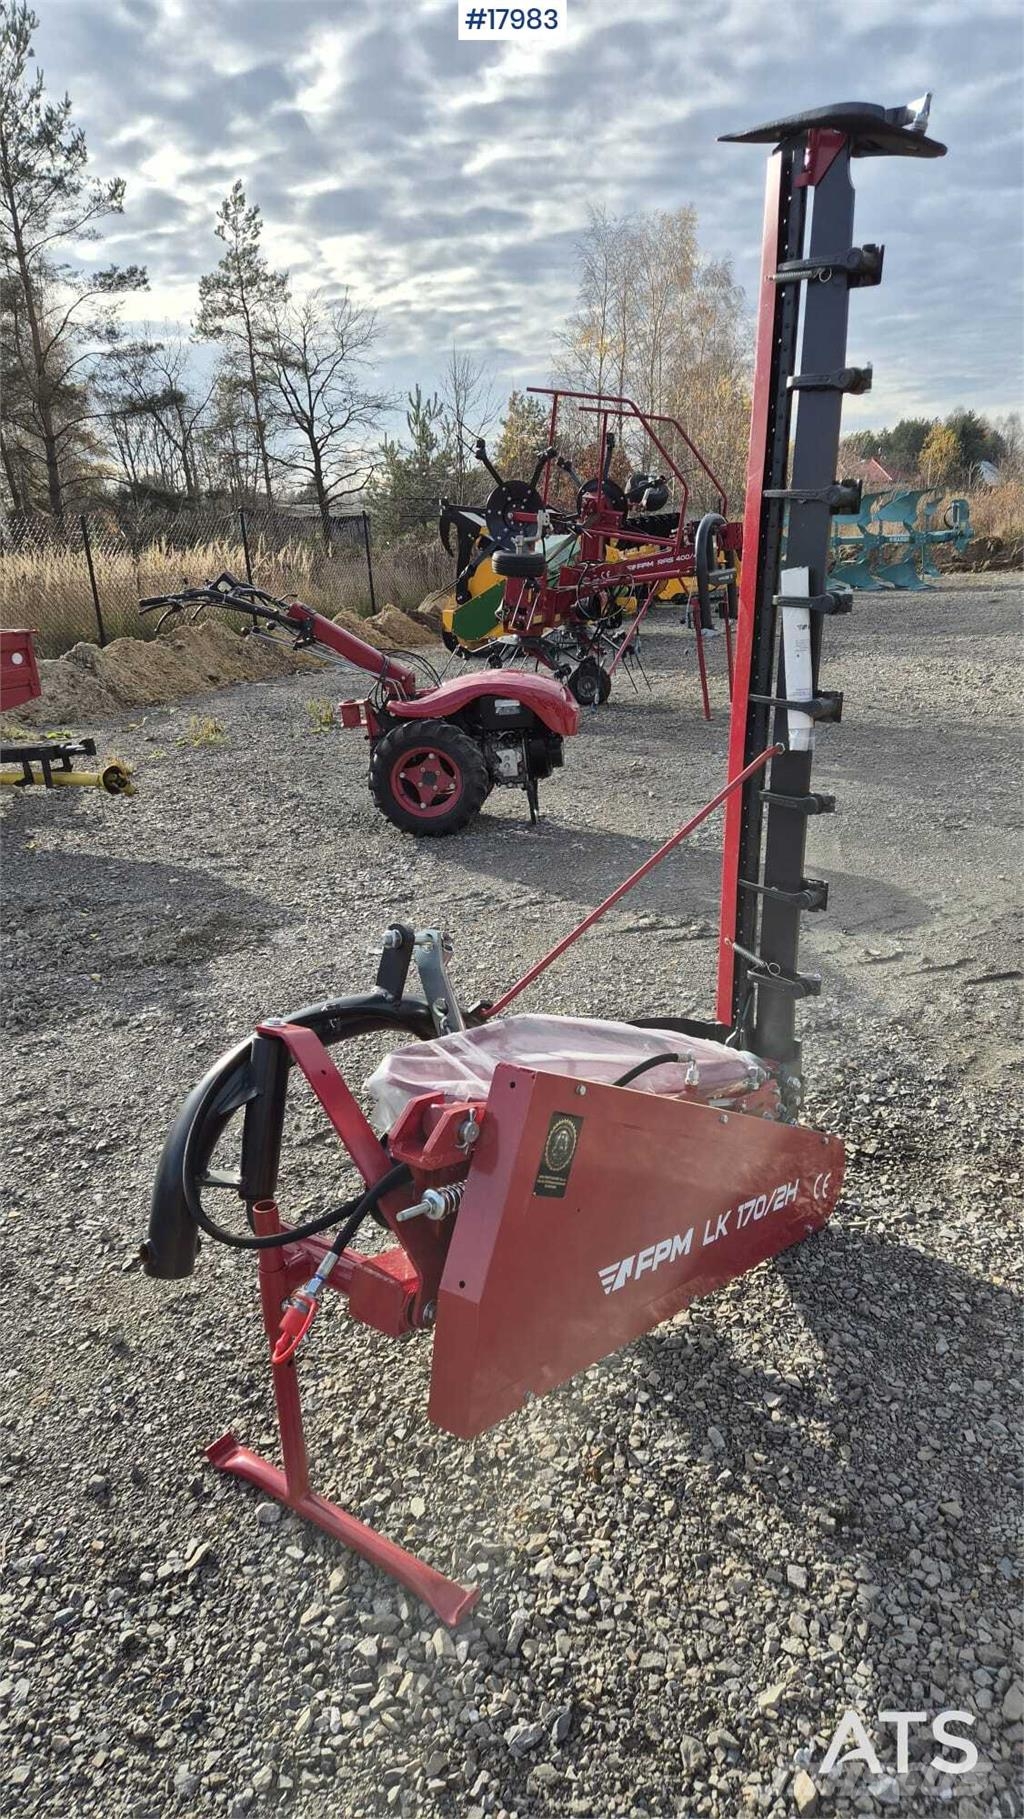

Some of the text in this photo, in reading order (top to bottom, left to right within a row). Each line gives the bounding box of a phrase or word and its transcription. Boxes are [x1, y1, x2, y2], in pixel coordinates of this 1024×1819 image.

[634, 1178, 800, 1280] FPM LK 170/2H
